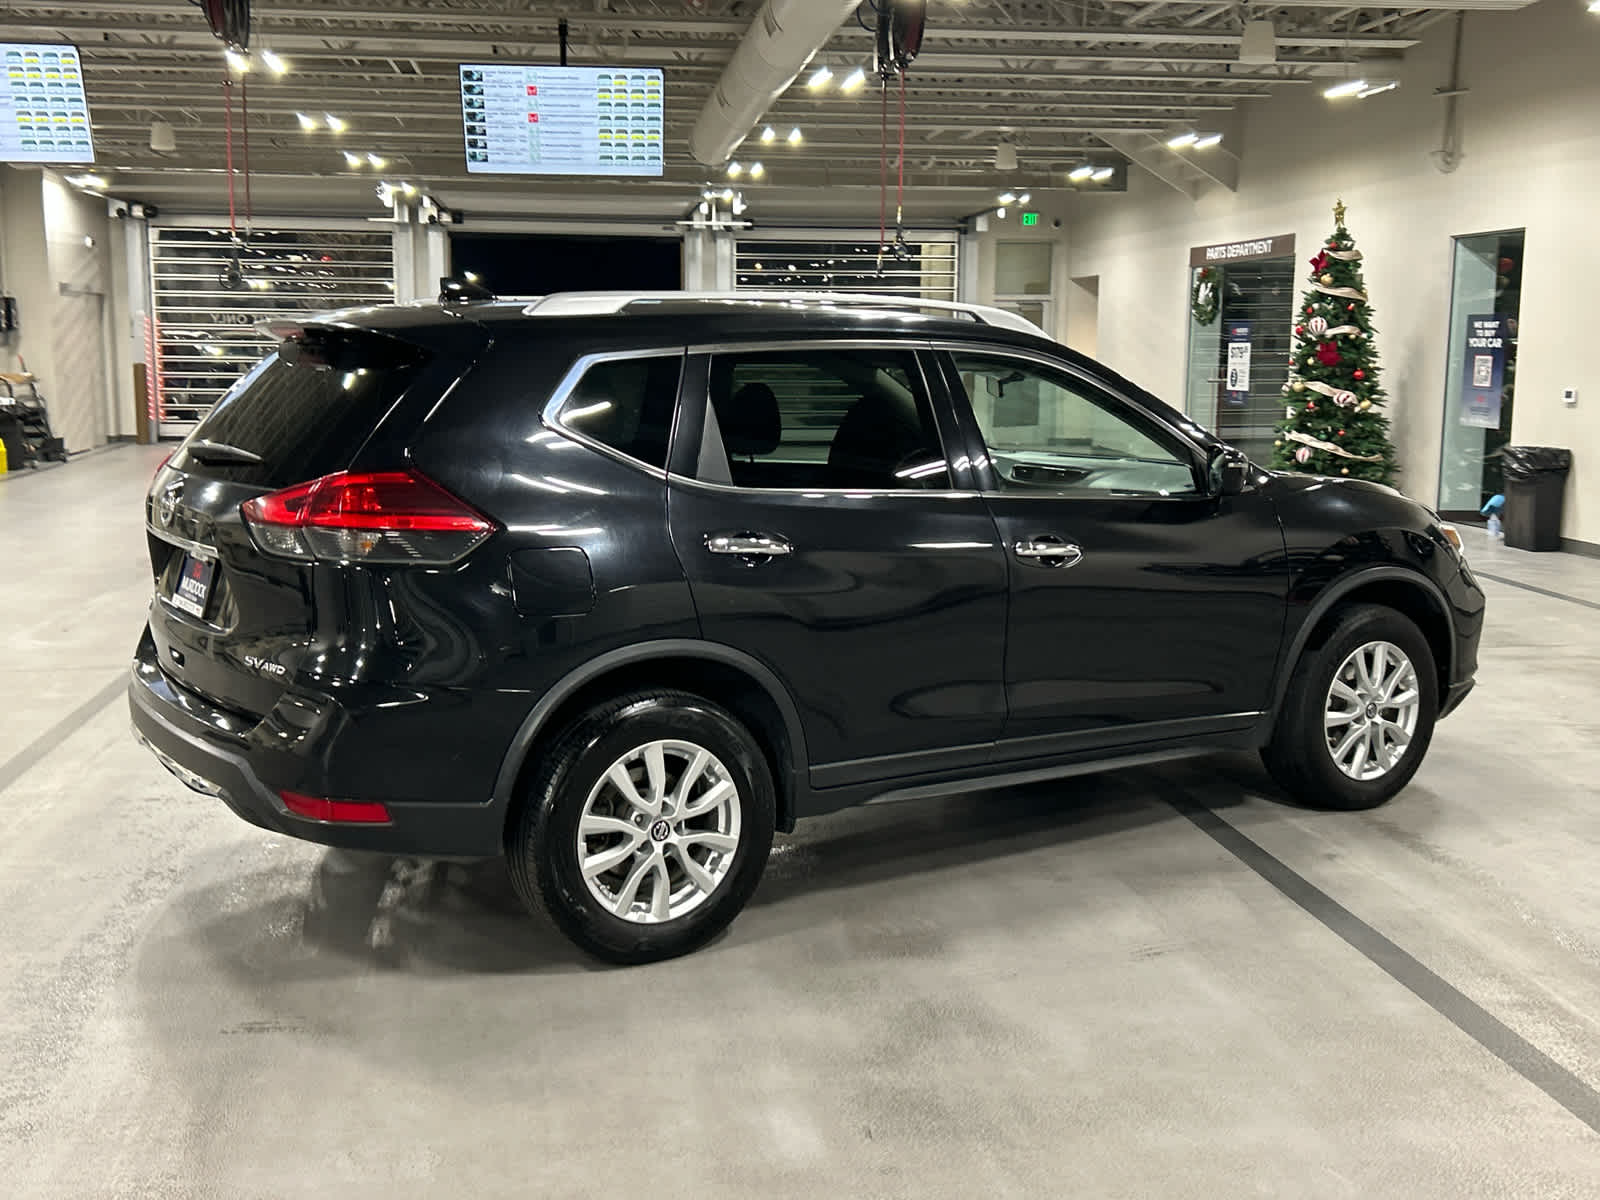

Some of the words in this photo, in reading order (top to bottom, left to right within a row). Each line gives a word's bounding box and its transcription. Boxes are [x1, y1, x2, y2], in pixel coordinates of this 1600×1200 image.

[1206, 246, 1226, 260] PARTS
[1227, 239, 1273, 258] DEPARTMENT
[1468, 338, 1487, 347] YOUR
[1487, 338, 1503, 348] CAR
[243, 655, 265, 669] SV
[261, 662, 286, 675] AWD
